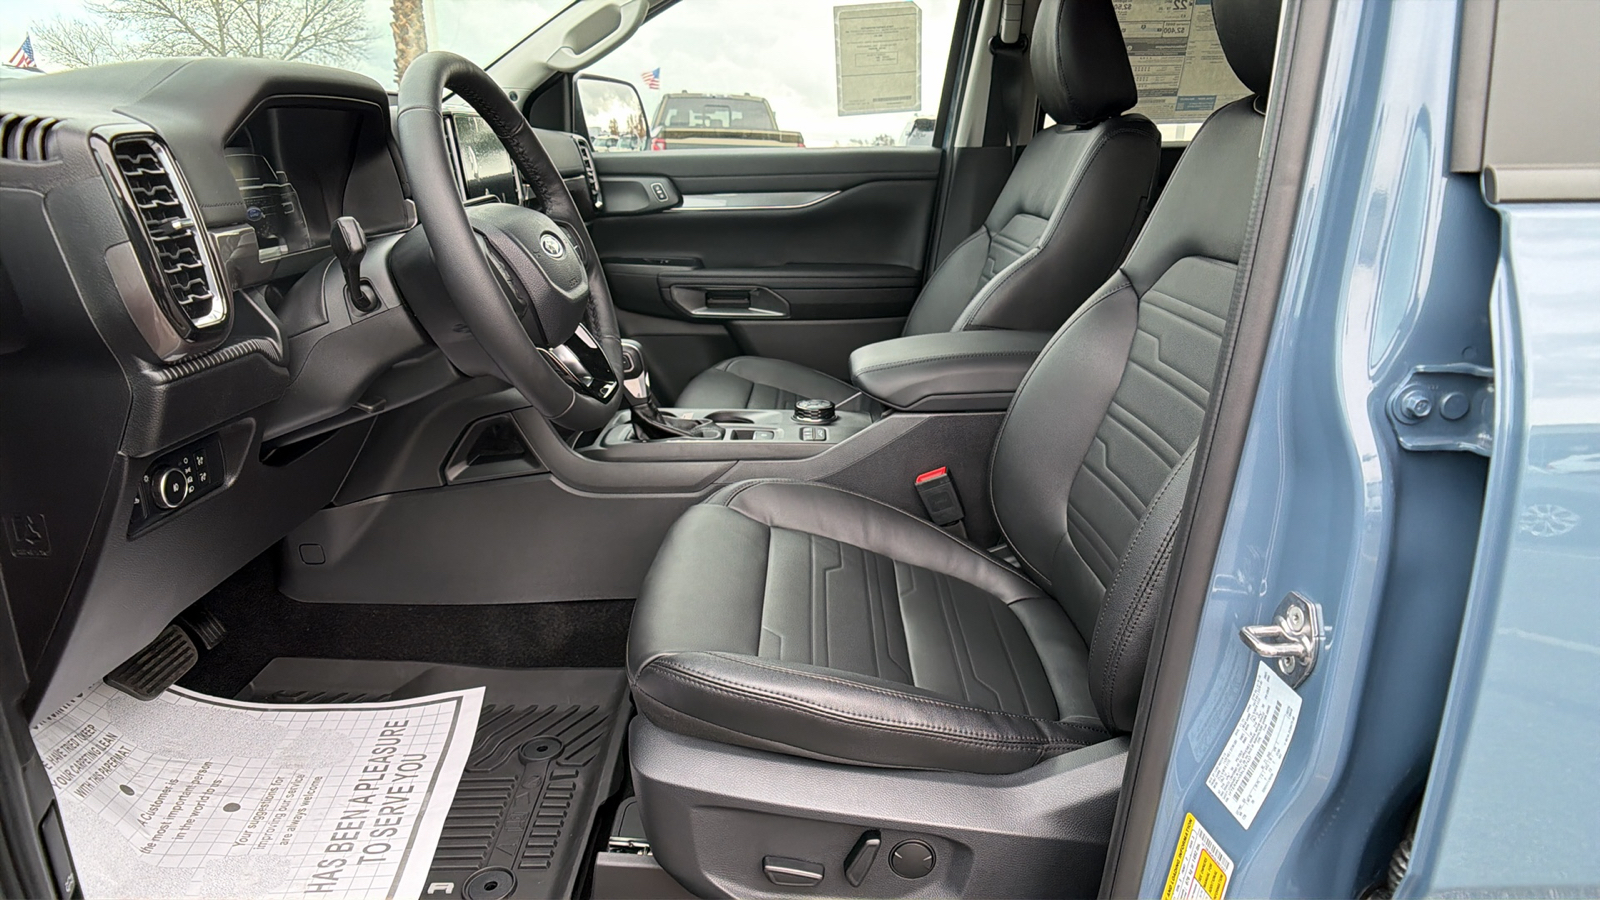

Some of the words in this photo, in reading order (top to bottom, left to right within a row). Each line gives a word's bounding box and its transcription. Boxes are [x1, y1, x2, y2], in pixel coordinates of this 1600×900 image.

[46, 747, 67, 766] HAVE
[60, 736, 80, 754] TRIED
[51, 769, 76, 790] YOUR
[70, 746, 101, 774] CARPETING
[354, 719, 410, 791] PLEASURE
[392, 753, 428, 782] YOU
[74, 781, 95, 798] WITH
[88, 771, 105, 786] THIS
[300, 776, 323, 807] welcome
[348, 794, 376, 805] A
[140, 785, 173, 821] Customer
[140, 842, 156, 854] the
[151, 821, 172, 841] most
[163, 784, 197, 820] important
[191, 761, 213, 784] person
[171, 832, 187, 840] in
[179, 819, 195, 831] the
[190, 796, 210, 818] world
[232, 830, 254, 847] Your
[247, 787, 279, 829] suggestions
[270, 776, 285, 786] for
[253, 813, 287, 850] improving
[278, 800, 291, 812] our
[286, 774, 306, 798] service
[286, 808, 307, 832] always
[369, 785, 415, 838] SERVE
[137, 818, 148, 827] A
[280, 833, 293, 846] are
[324, 809, 370, 853] BEEN
[357, 842, 391, 865] TO
[304, 858, 347, 894] HAS
